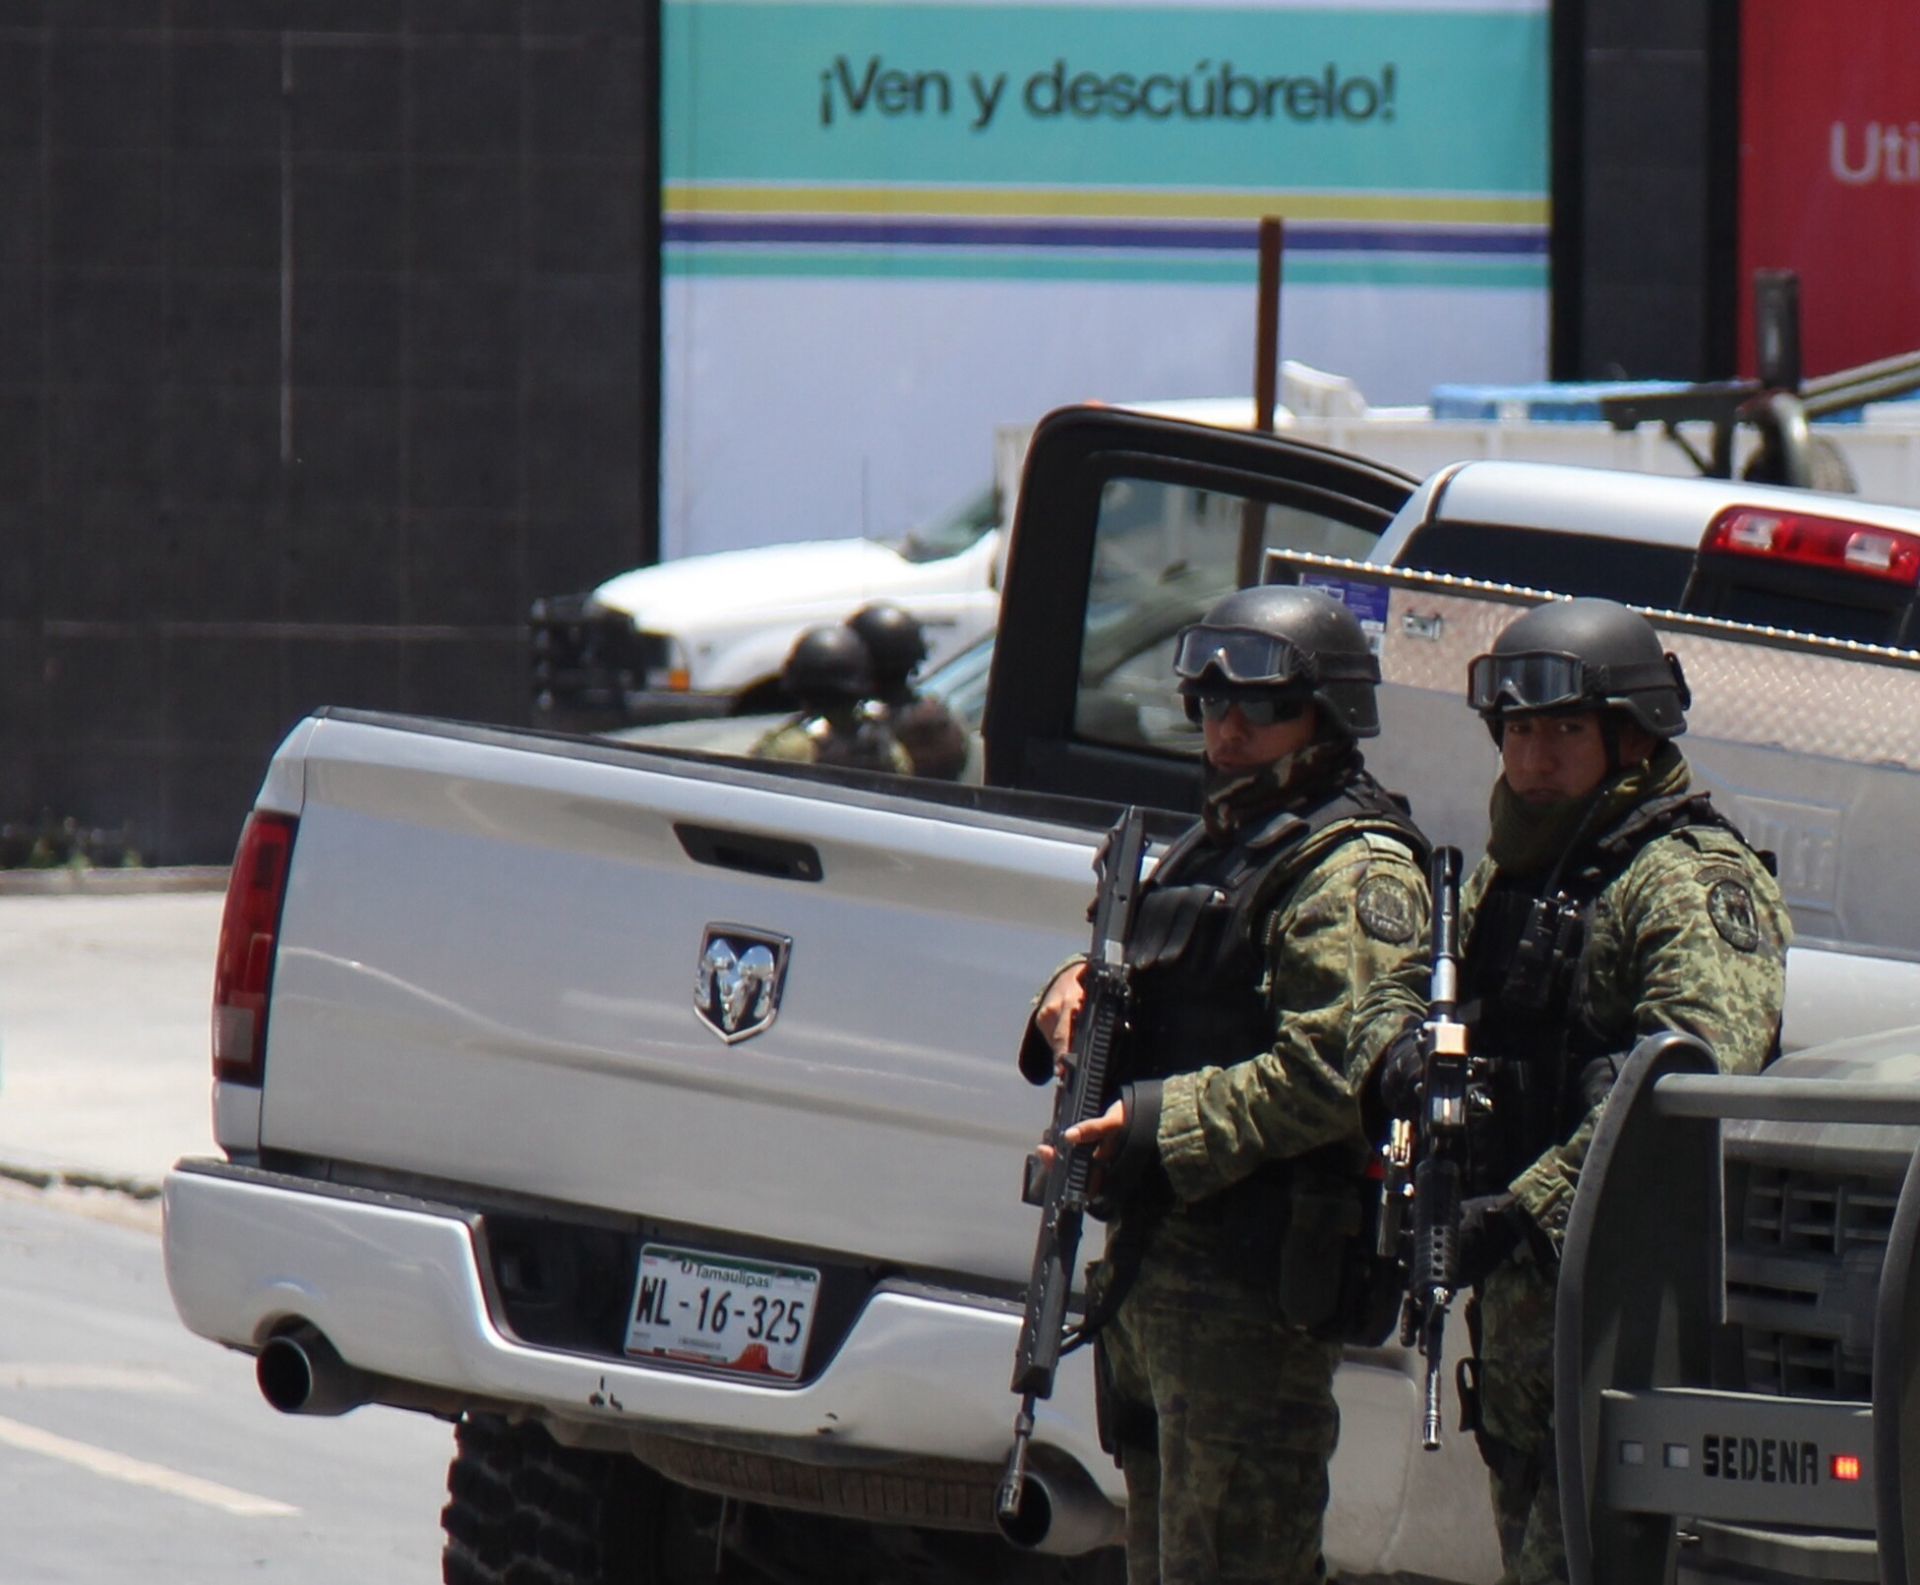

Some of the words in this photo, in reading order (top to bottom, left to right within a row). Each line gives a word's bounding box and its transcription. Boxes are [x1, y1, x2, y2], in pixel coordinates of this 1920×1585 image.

[820, 55, 951, 128] ¡Ven
[968, 72, 1006, 131] y
[1023, 59, 1397, 122] descúbrelo!
[695, 1263, 770, 1288] Tamaulipas
[635, 1275, 804, 1344] WL-16-325
[1703, 1434, 1819, 1486] SEDENA
